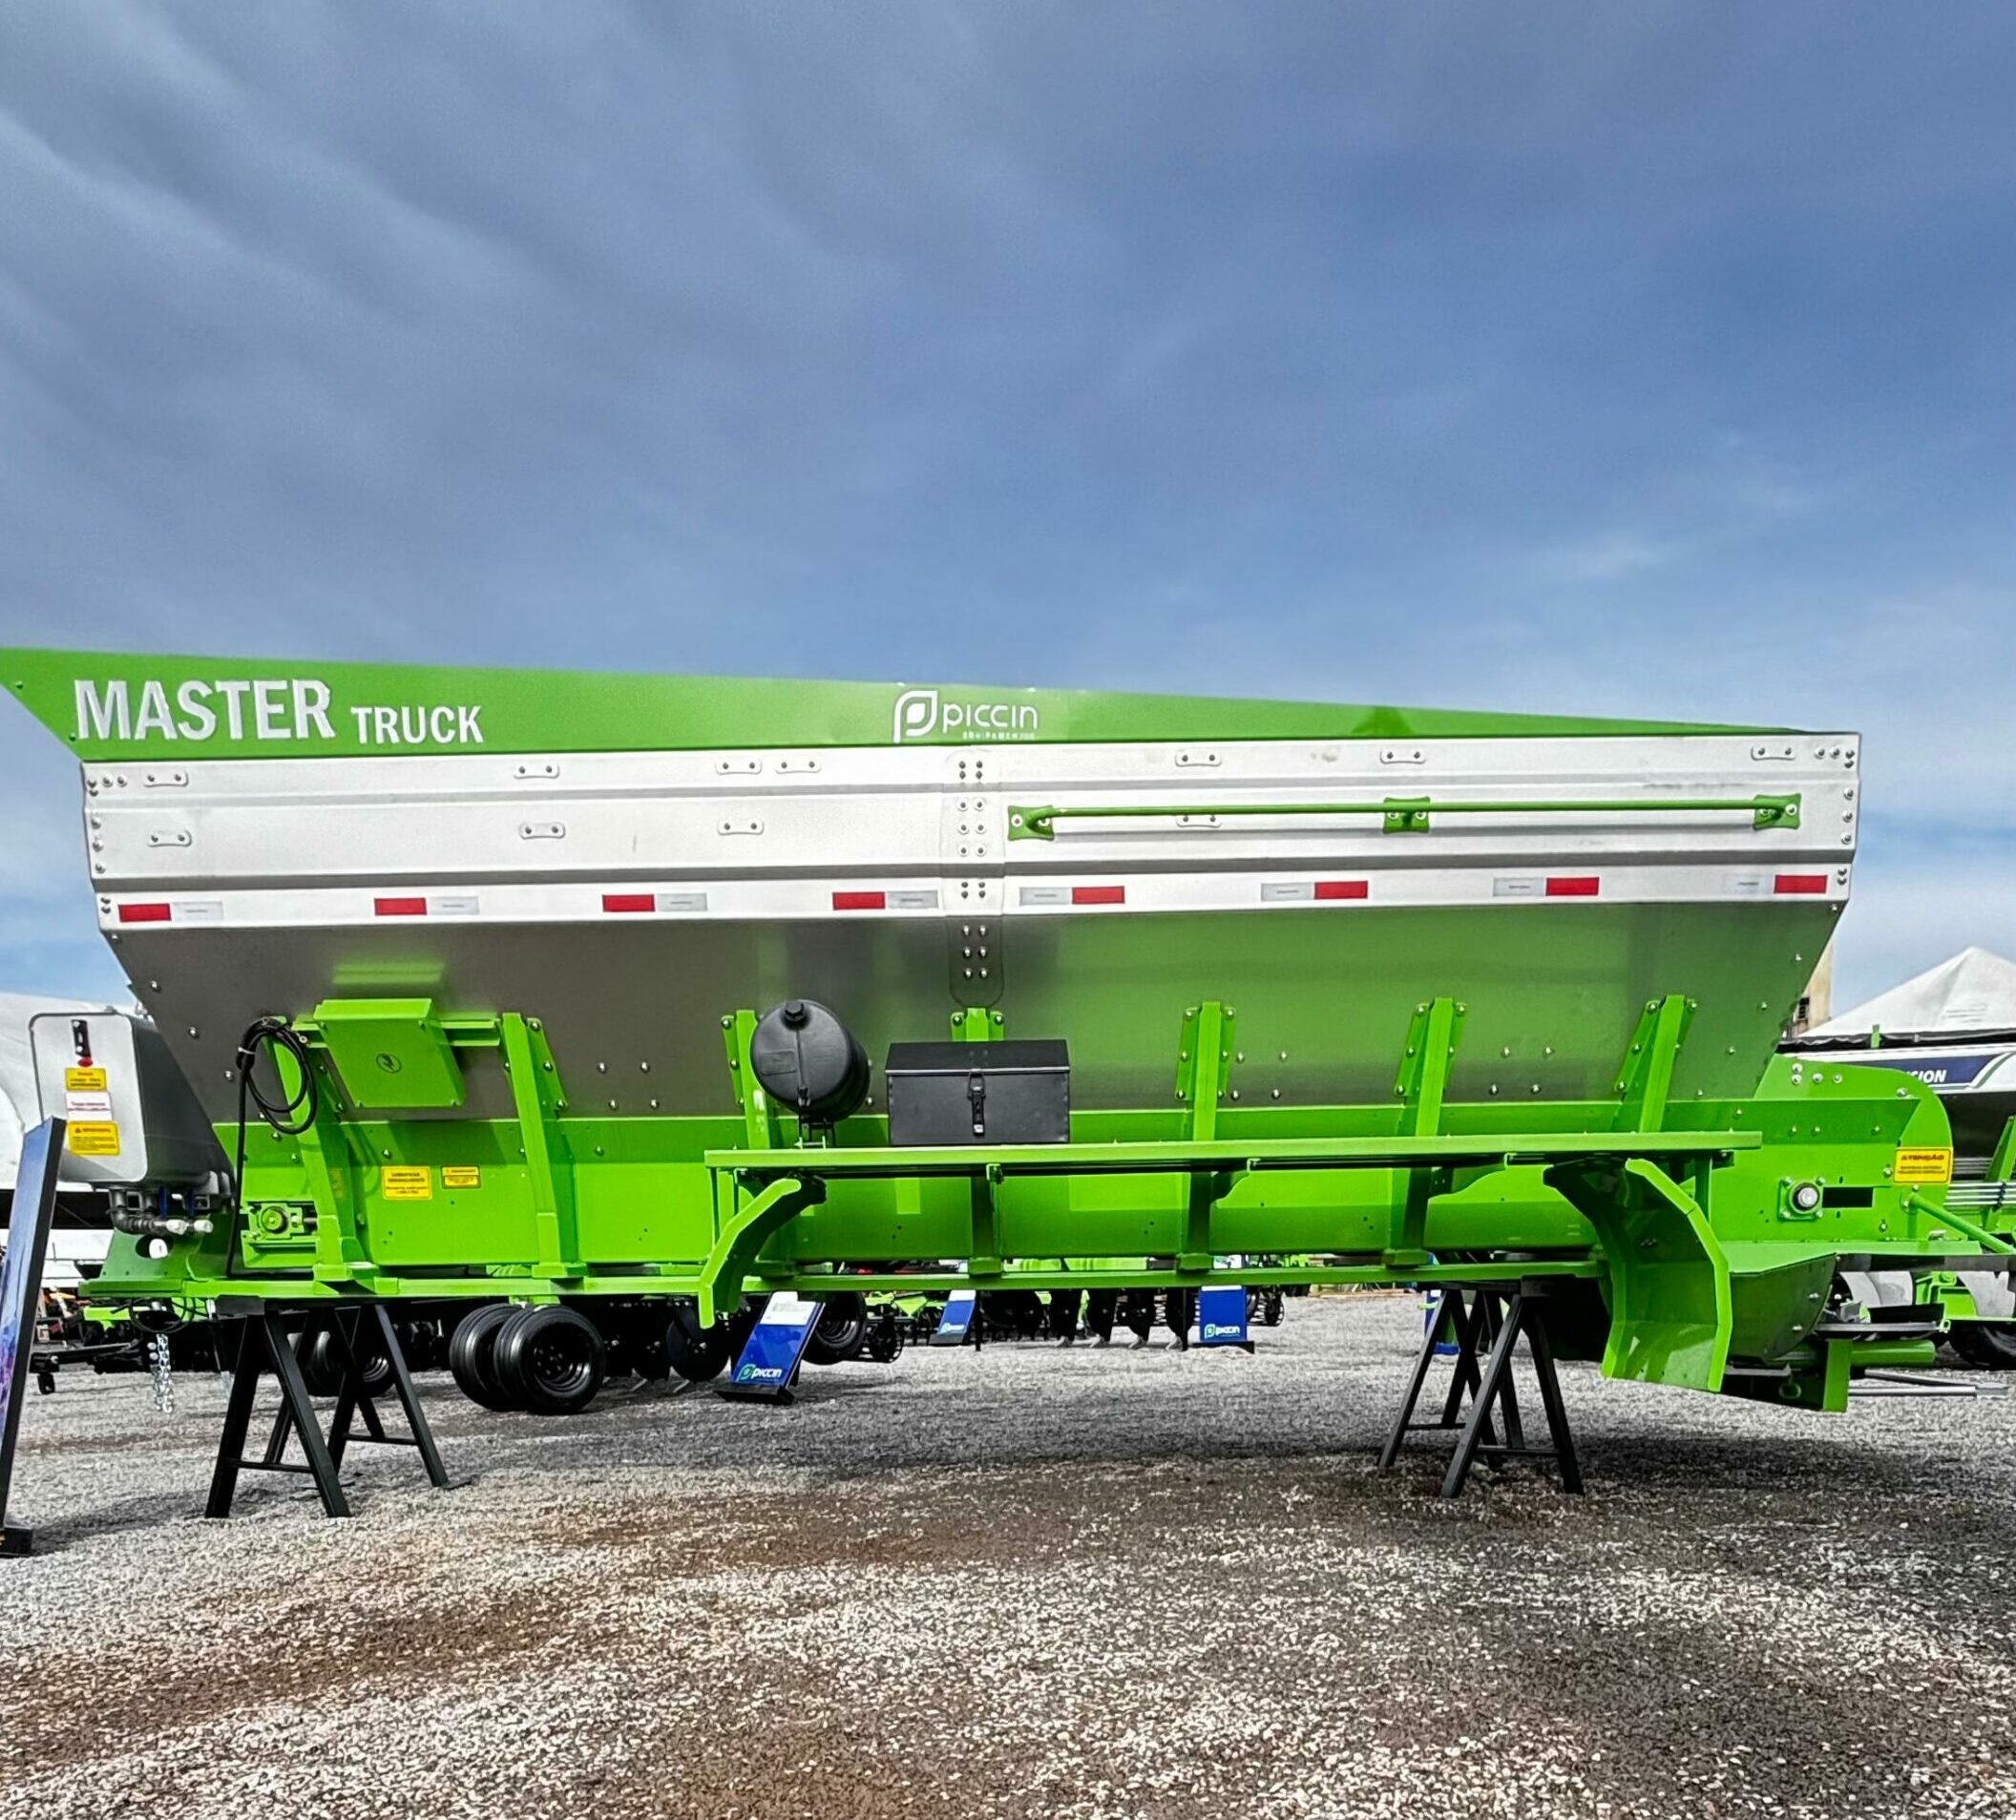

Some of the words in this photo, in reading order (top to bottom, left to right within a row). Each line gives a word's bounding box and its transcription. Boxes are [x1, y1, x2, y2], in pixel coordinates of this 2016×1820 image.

[74, 680, 336, 741] MASTER
[351, 705, 484, 744] TRUCK
[942, 703, 1038, 734] piccin
[750, 1367, 783, 1379] piccin
